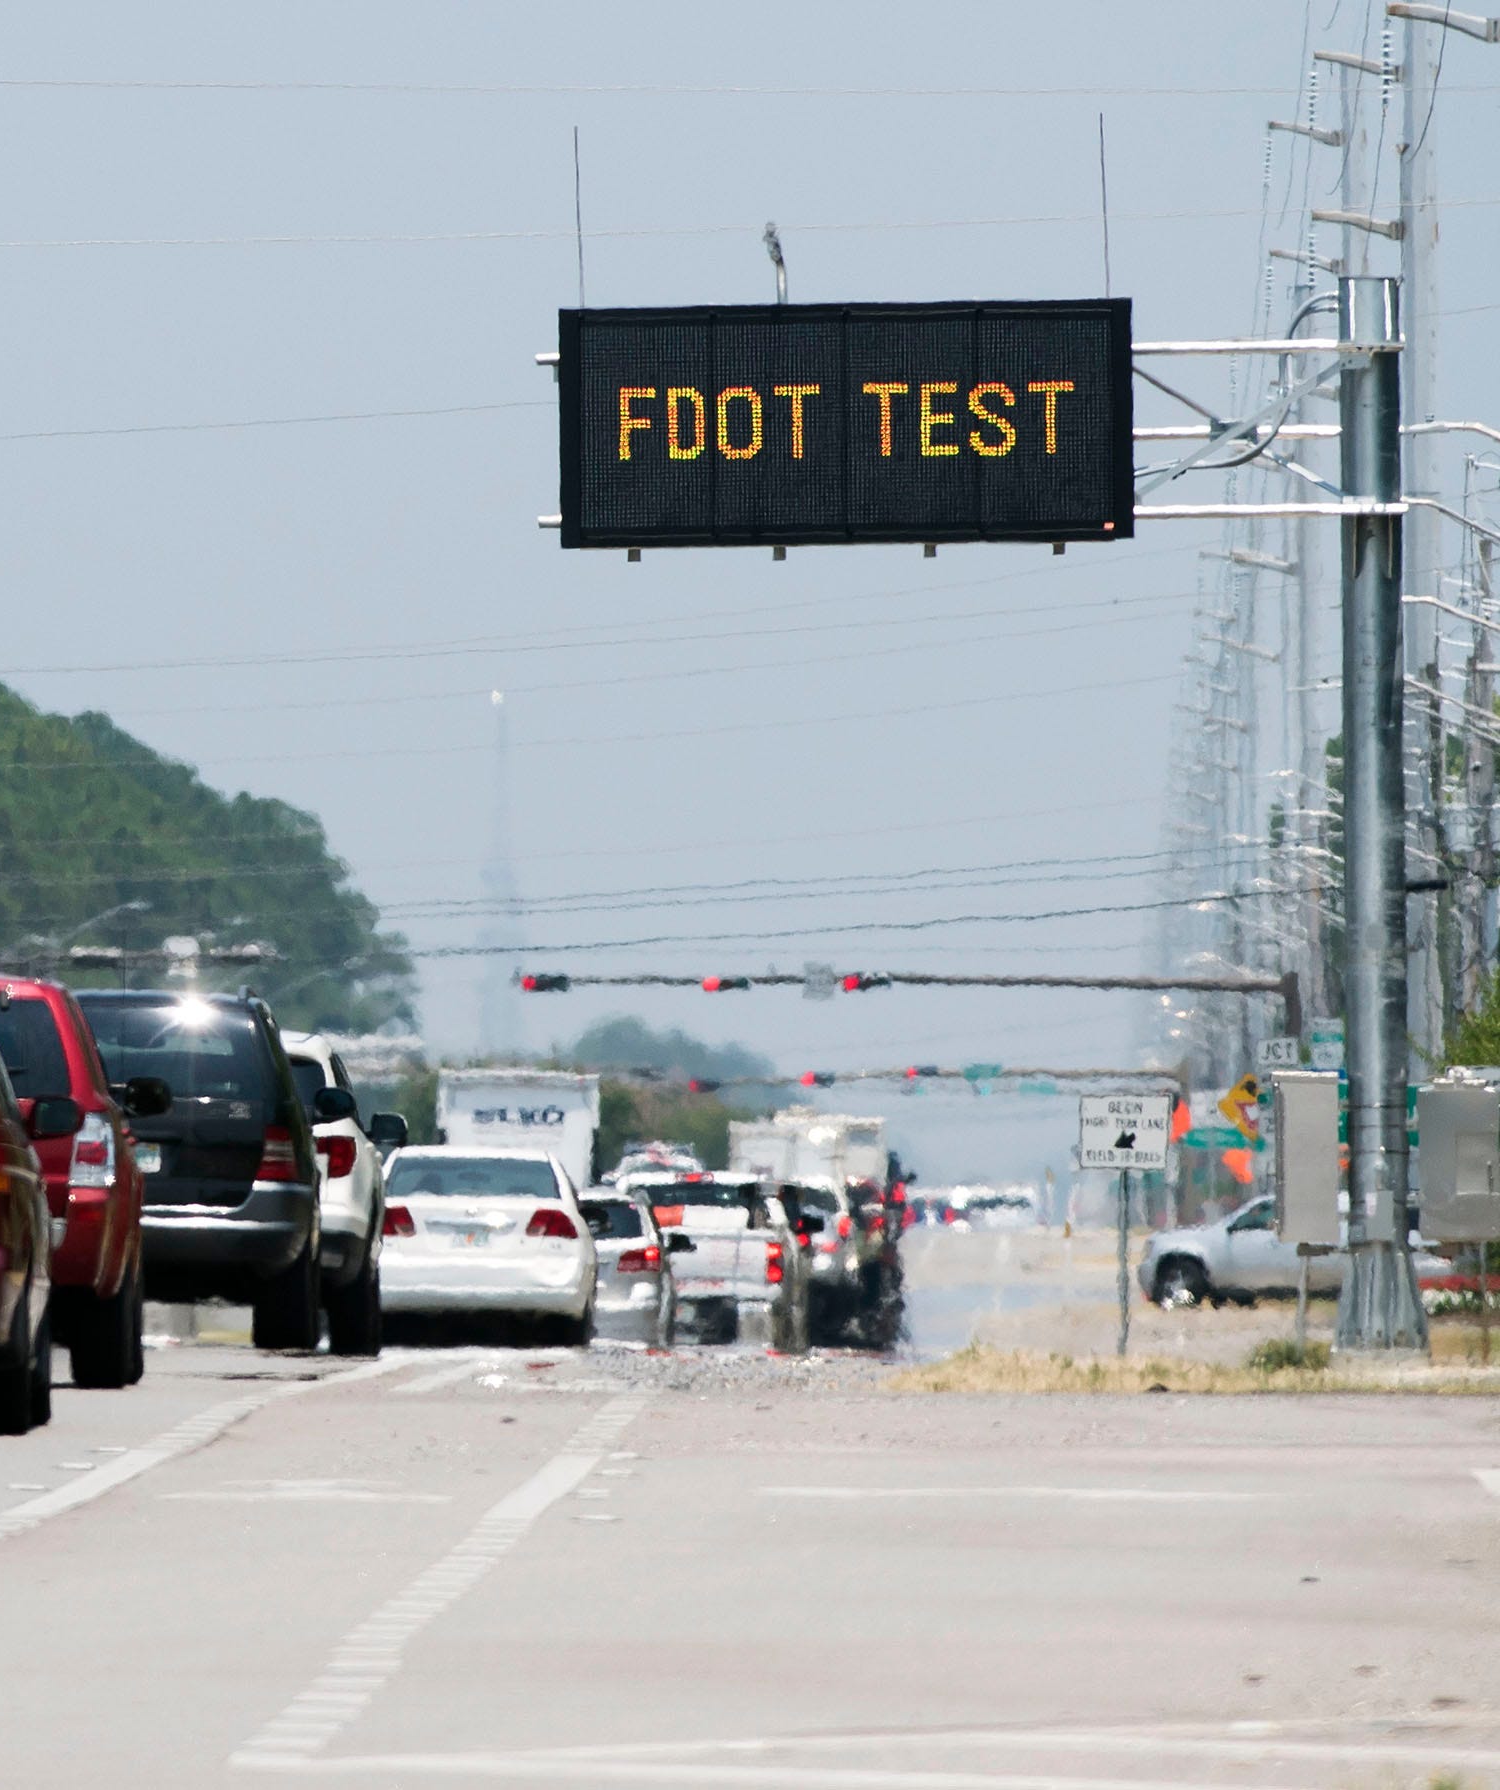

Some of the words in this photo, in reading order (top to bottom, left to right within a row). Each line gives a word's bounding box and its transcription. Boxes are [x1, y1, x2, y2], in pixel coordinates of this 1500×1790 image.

[618, 385, 819, 460] FDOT
[862, 381, 1074, 457] TEST
[1261, 1042, 1293, 1060] JCT
[1108, 1101, 1143, 1114] BEGIN
